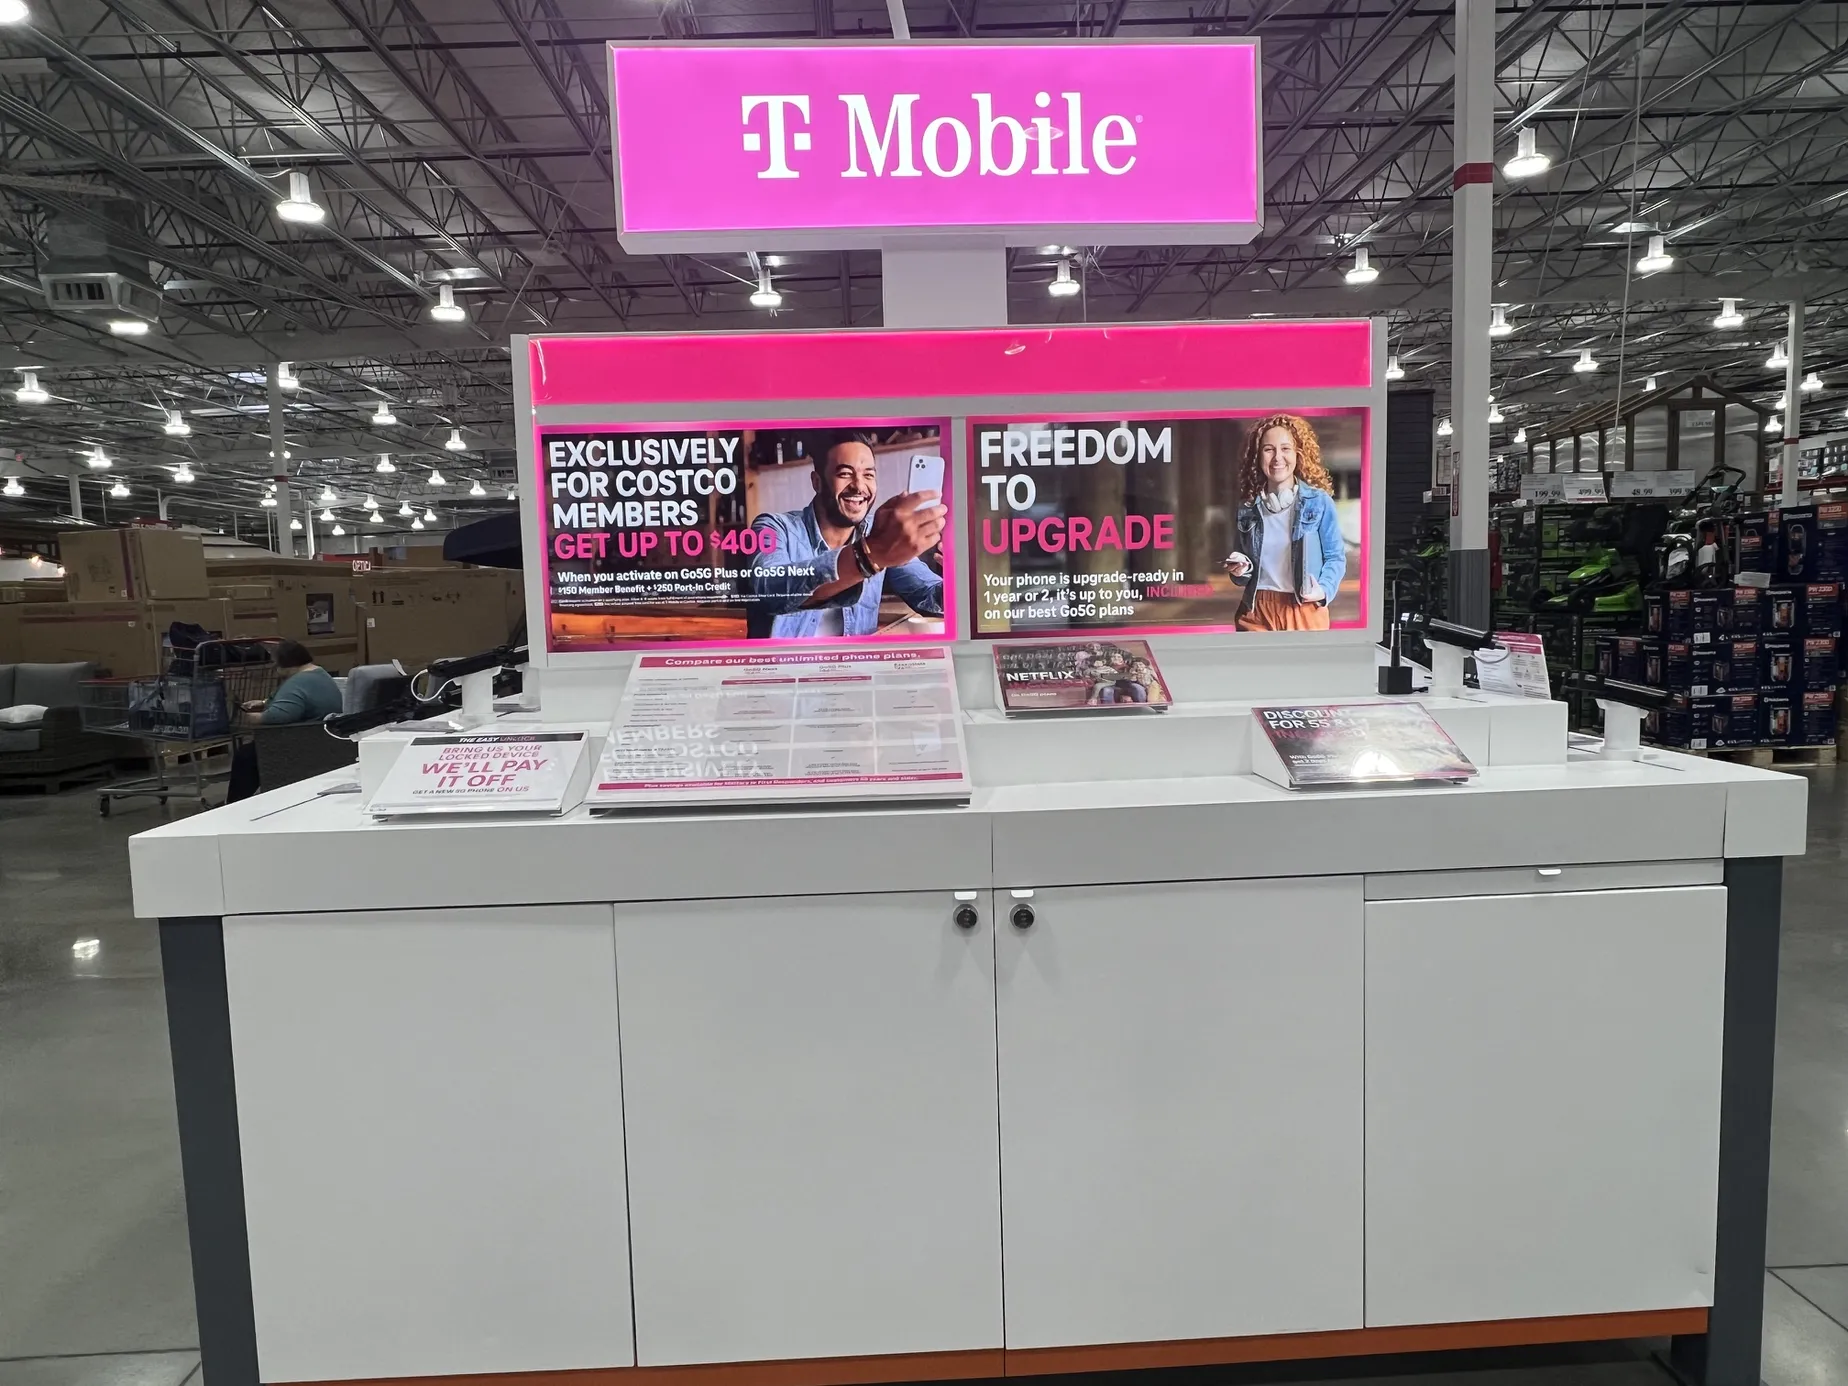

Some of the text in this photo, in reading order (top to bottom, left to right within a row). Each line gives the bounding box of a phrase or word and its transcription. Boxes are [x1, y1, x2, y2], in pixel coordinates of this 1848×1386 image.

[741, 92, 1138, 178] T Mobile
[548, 437, 740, 468] EXCLUSIVELY
[980, 427, 1172, 467] FREEDOM
[551, 468, 736, 498] FOR COSTCO
[981, 474, 1036, 510] TO
[1534, 489, 1561, 498] 199.99
[553, 501, 699, 529] MEMBERS
[982, 513, 1175, 554] UPGRADE
[554, 528, 778, 560] GET UP TO $400
[558, 565, 815, 584] When you activate on Go5G Plus or Go5G Next
[983, 569, 1184, 587] Your phone is upgrade-ready in
[558, 586, 578, 595] $150
[578, 584, 613, 594] Member
[615, 583, 645, 593] Benefit
[653, 583, 673, 593] $250
[674, 582, 704, 592] Port-In
[705, 582, 731, 591] Credit
[984, 592, 990, 603] 1
[993, 592, 1020, 606] year
[1025, 591, 1039, 602] or
[1041, 590, 1053, 604] 2,
[1056, 588, 1076, 601] it's
[1079, 590, 1096, 604] up
[1099, 589, 1113, 600] to
[1116, 587, 1143, 602] you,
[984, 602, 1134, 620] on our best Go5G plans
[665, 657, 723, 667] Compare
[725, 657, 746, 665] our
[749, 655, 776, 664] best
[778, 654, 839, 663] unlimited
[842, 652, 880, 662] phone
[1006, 670, 1075, 682] NETFLIX
[1269, 719, 1306, 729] FOR
[1308, 718, 1330, 729] 55
[438, 751, 539, 761] LOCKED DEVICE
[443, 744, 543, 754] BRING US YOUR
[422, 759, 548, 775] WE'LL PAY
[437, 773, 517, 788] IT OFF
